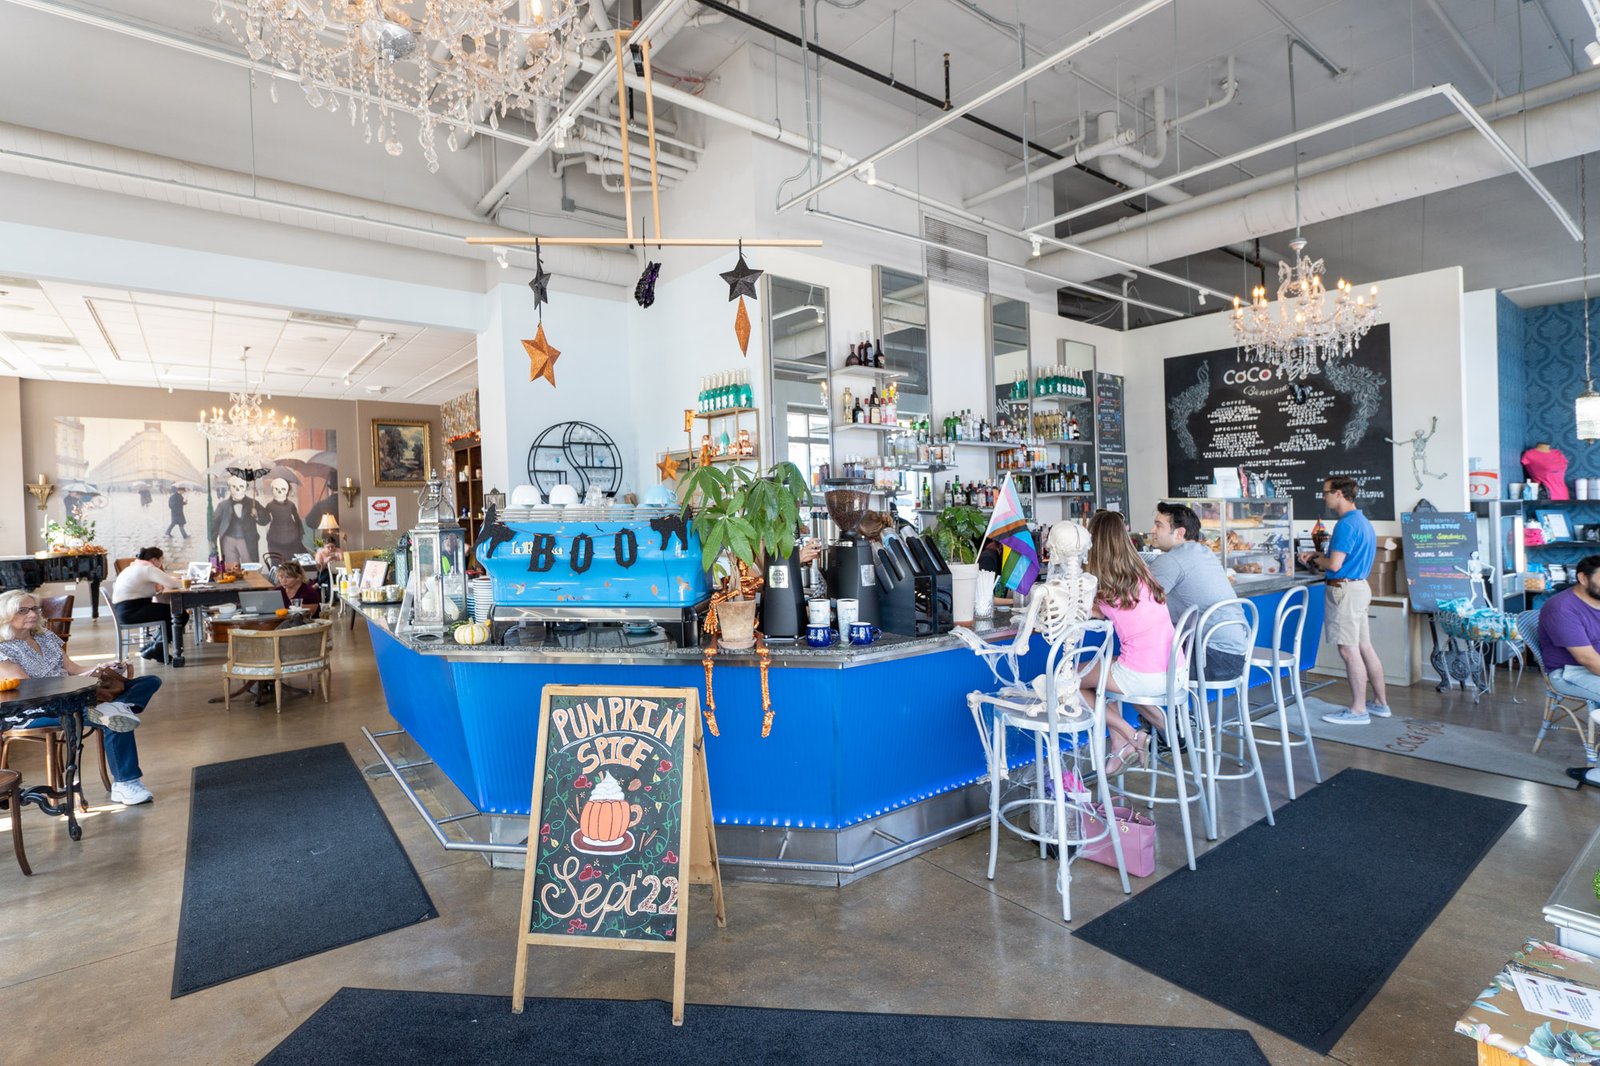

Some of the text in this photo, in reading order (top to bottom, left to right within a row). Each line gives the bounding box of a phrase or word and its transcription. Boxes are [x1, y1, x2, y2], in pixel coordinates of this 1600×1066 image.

[1215, 424, 1257, 432] SPECIALTIES
[552, 697, 685, 748] PUMPKIN
[577, 736, 653, 774] SPICE
